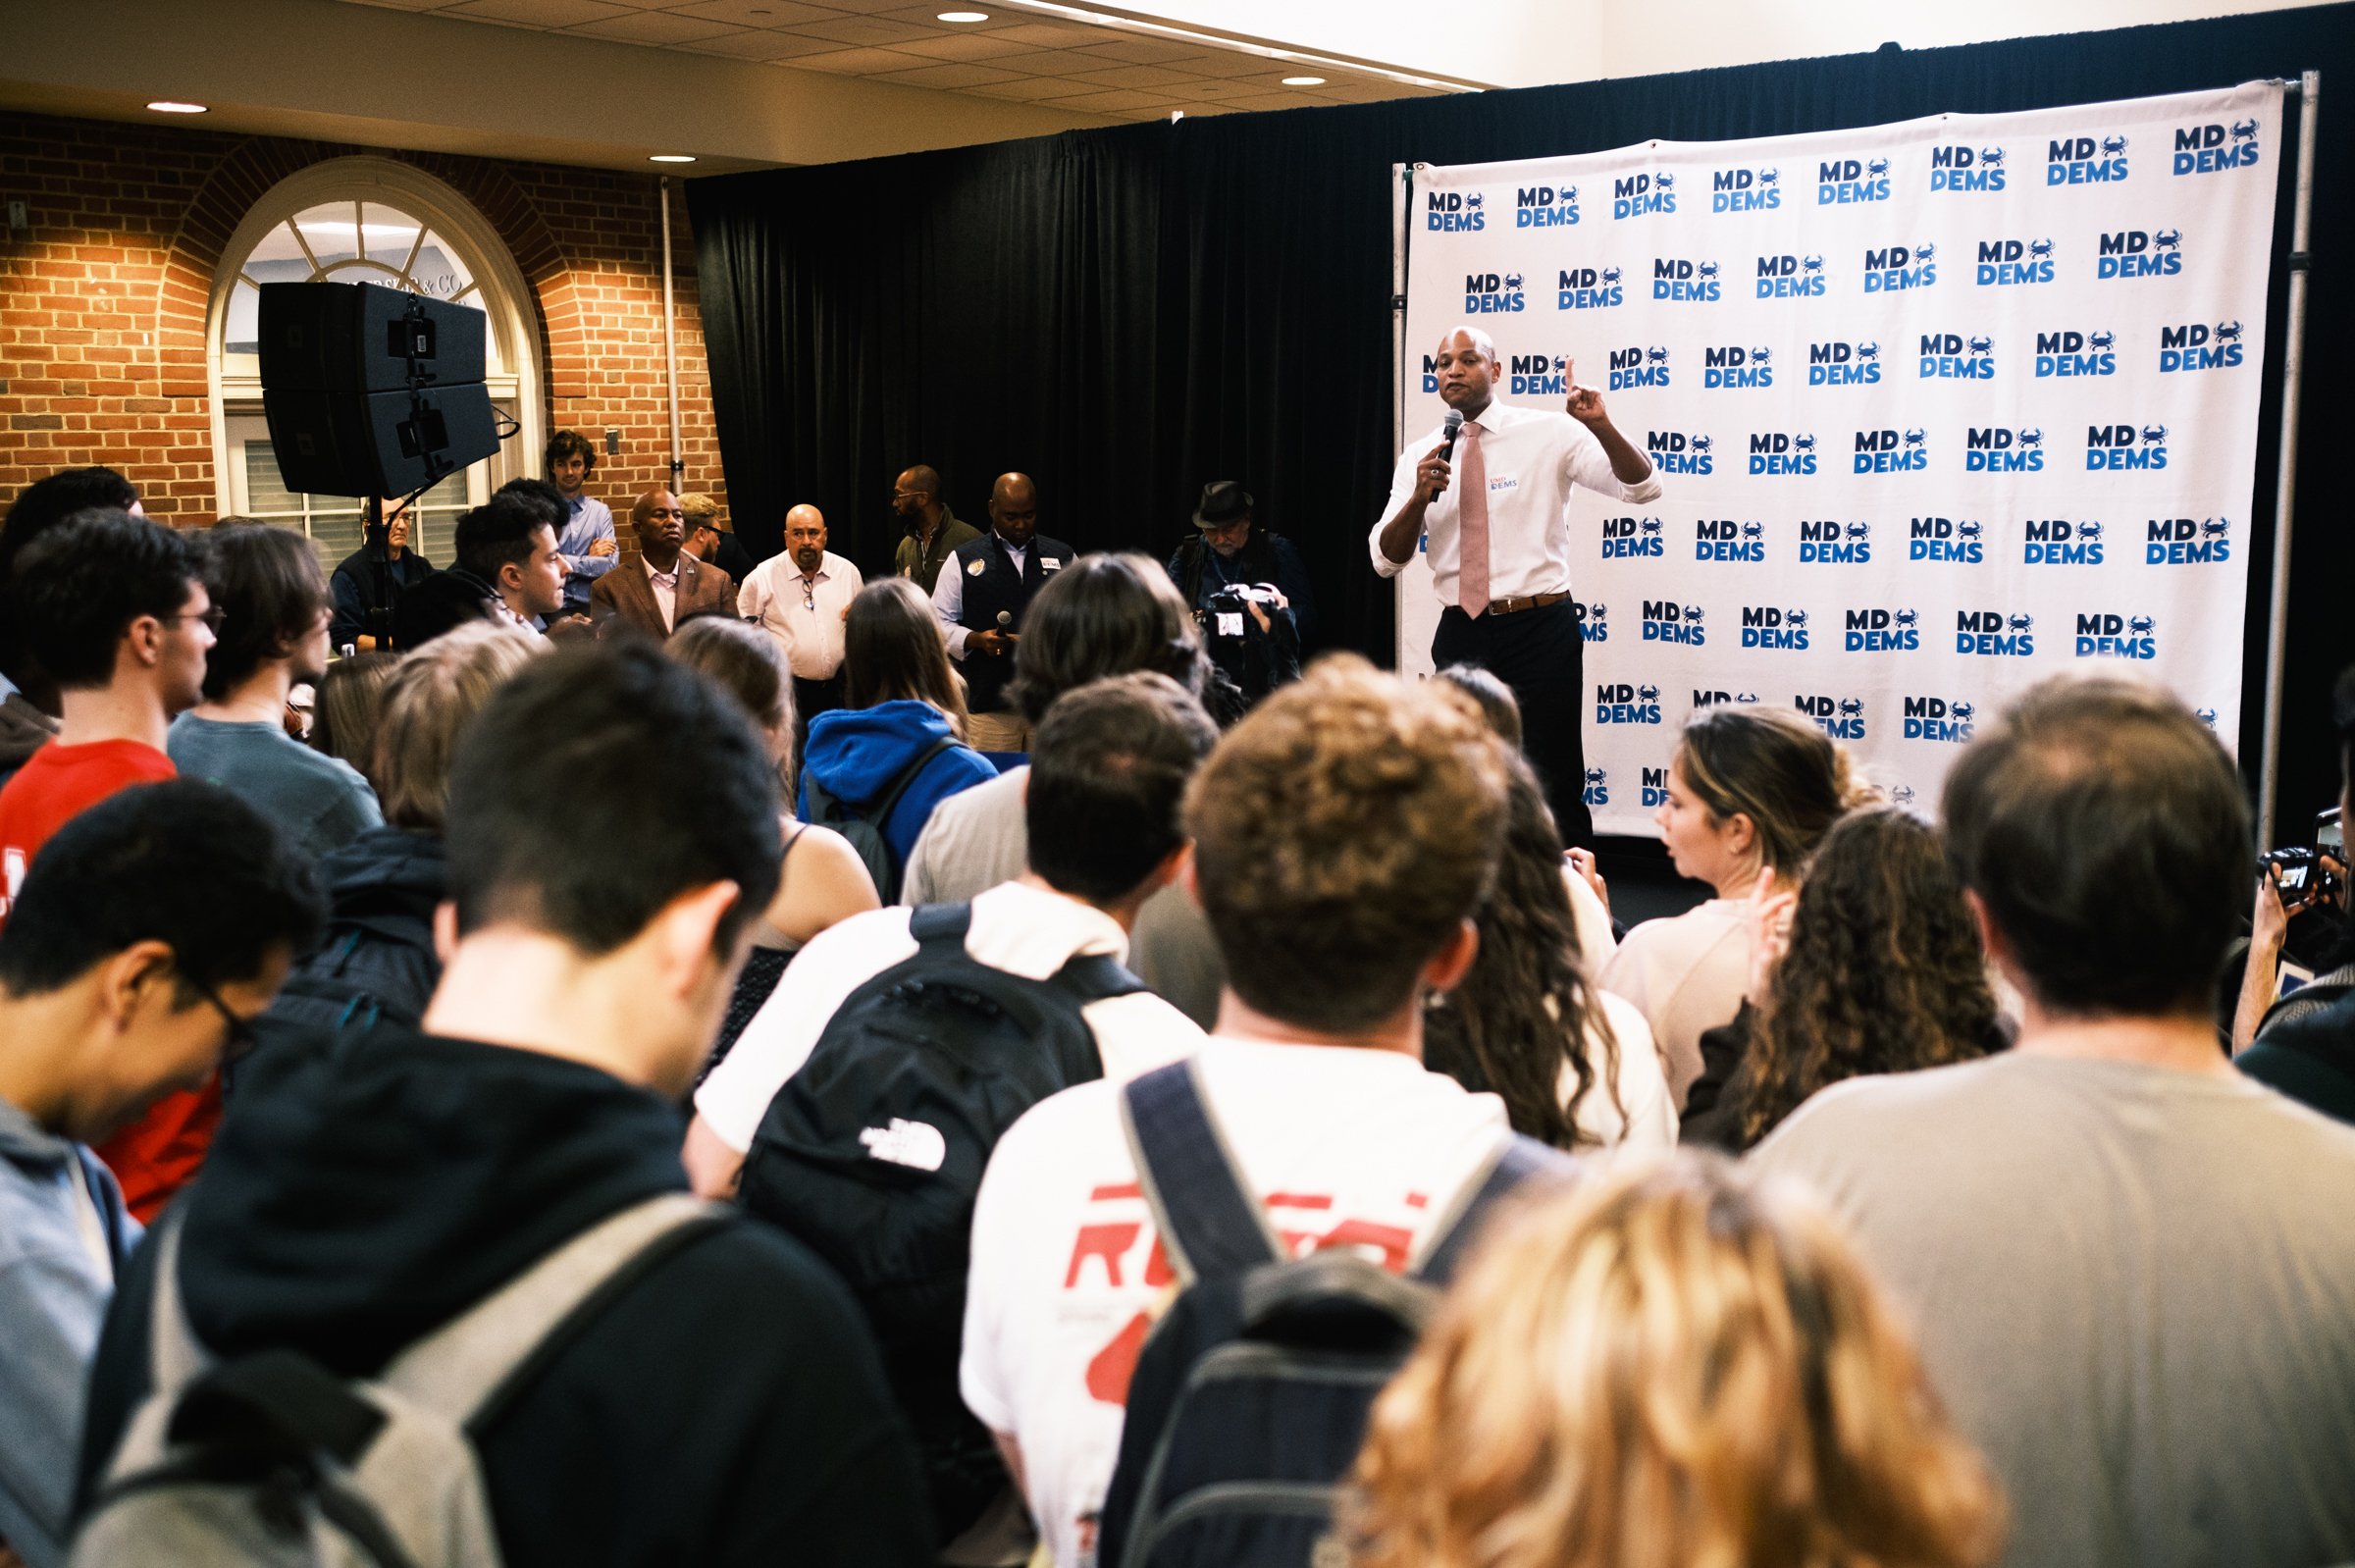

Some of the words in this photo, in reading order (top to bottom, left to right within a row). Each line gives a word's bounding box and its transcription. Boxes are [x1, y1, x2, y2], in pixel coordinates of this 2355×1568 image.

[2175, 125, 2225, 151] MD
[1932, 146, 1974, 168] MD
[2049, 138, 2096, 162] MD
[2173, 141, 2259, 176] DEMS
[1714, 170, 1753, 191] MD
[1820, 161, 1861, 183] MD
[1931, 170, 2005, 191] DEMS
[2048, 158, 2127, 185] DEMS
[1518, 187, 1553, 207] MD
[1615, 175, 1649, 198] MD
[1819, 180, 1890, 204] DEMS
[1429, 192, 1461, 211] MD
[1614, 193, 1675, 220] DEMS
[1713, 188, 1780, 212] DEMS
[1428, 212, 1485, 232] DEMS
[1517, 205, 1579, 228] DEMS
[1978, 240, 2023, 262] MD
[2100, 232, 2148, 255] MD
[1654, 259, 1693, 279] MD
[1757, 256, 1797, 277] MD
[1865, 247, 1909, 270] MD
[2098, 252, 2181, 279] DEMS
[1466, 274, 1500, 293] MD
[1559, 269, 1596, 289] MD
[1864, 264, 1935, 292] DEMS
[1977, 261, 2054, 285] DEMS
[1653, 281, 1720, 301] DEMS
[1757, 276, 1825, 298] DEMS
[1466, 292, 1524, 313] DEMS
[1559, 287, 1622, 310] DEMS
[1921, 334, 1962, 355] MD
[2037, 332, 2083, 354] MD
[2162, 325, 2209, 348] MD
[1610, 347, 1642, 370] MD
[1705, 347, 1746, 367] MD
[1810, 342, 1851, 363] MD
[2160, 343, 2243, 372] DEMS
[1512, 355, 1548, 374] MD
[1809, 363, 1880, 385] DEMS
[1920, 357, 1994, 379] DEMS
[2036, 353, 2116, 377] DEMS
[1610, 367, 1669, 391] DEMS
[1705, 367, 1772, 388] DEMS
[1648, 432, 1686, 451] MD
[1751, 434, 1789, 453] MD
[1856, 431, 1899, 451] MD
[1967, 428, 2013, 449] MD
[2088, 425, 2135, 447] MD
[1750, 454, 1816, 475] DEMS
[1854, 449, 1927, 474] DEMS
[1966, 450, 2043, 472] DEMS
[2087, 447, 2167, 470] DEMS
[1491, 480, 1517, 491] DEMS
[1603, 518, 1636, 538] MD
[1697, 520, 1738, 540] MD
[1801, 521, 1840, 541] MD
[1911, 518, 1952, 539] MD
[2026, 521, 2071, 542] MD
[2148, 519, 2197, 541] MD
[1602, 537, 1663, 558] DEMS
[1697, 542, 1764, 561] DEMS
[1800, 543, 1870, 563] DEMS
[1910, 540, 1983, 563] DEMS
[2024, 544, 2103, 564] DEMS
[2147, 540, 2229, 564] DEMS
[1573, 602, 1588, 621] D
[1644, 601, 1680, 621] MD
[1743, 607, 1781, 627] MD
[1846, 609, 1890, 630] MD
[1580, 622, 1608, 642] MS
[1958, 611, 2003, 633] MD
[2077, 614, 2123, 635] MD
[1643, 621, 1704, 646] DEMS
[1742, 628, 1808, 650] DEMS
[1846, 630, 1919, 652] DEMS
[1957, 633, 2033, 655] DEMS
[2076, 637, 2156, 659] DEMS
[1597, 684, 1634, 704] MD
[1596, 705, 1661, 724] DEMS
[1795, 696, 1836, 717] MD
[1905, 697, 1946, 718] MD
[1904, 718, 1974, 743] DEMS
[1642, 767, 1669, 788] M
[1581, 786, 1609, 805] MS
[1642, 787, 1672, 807] DE
